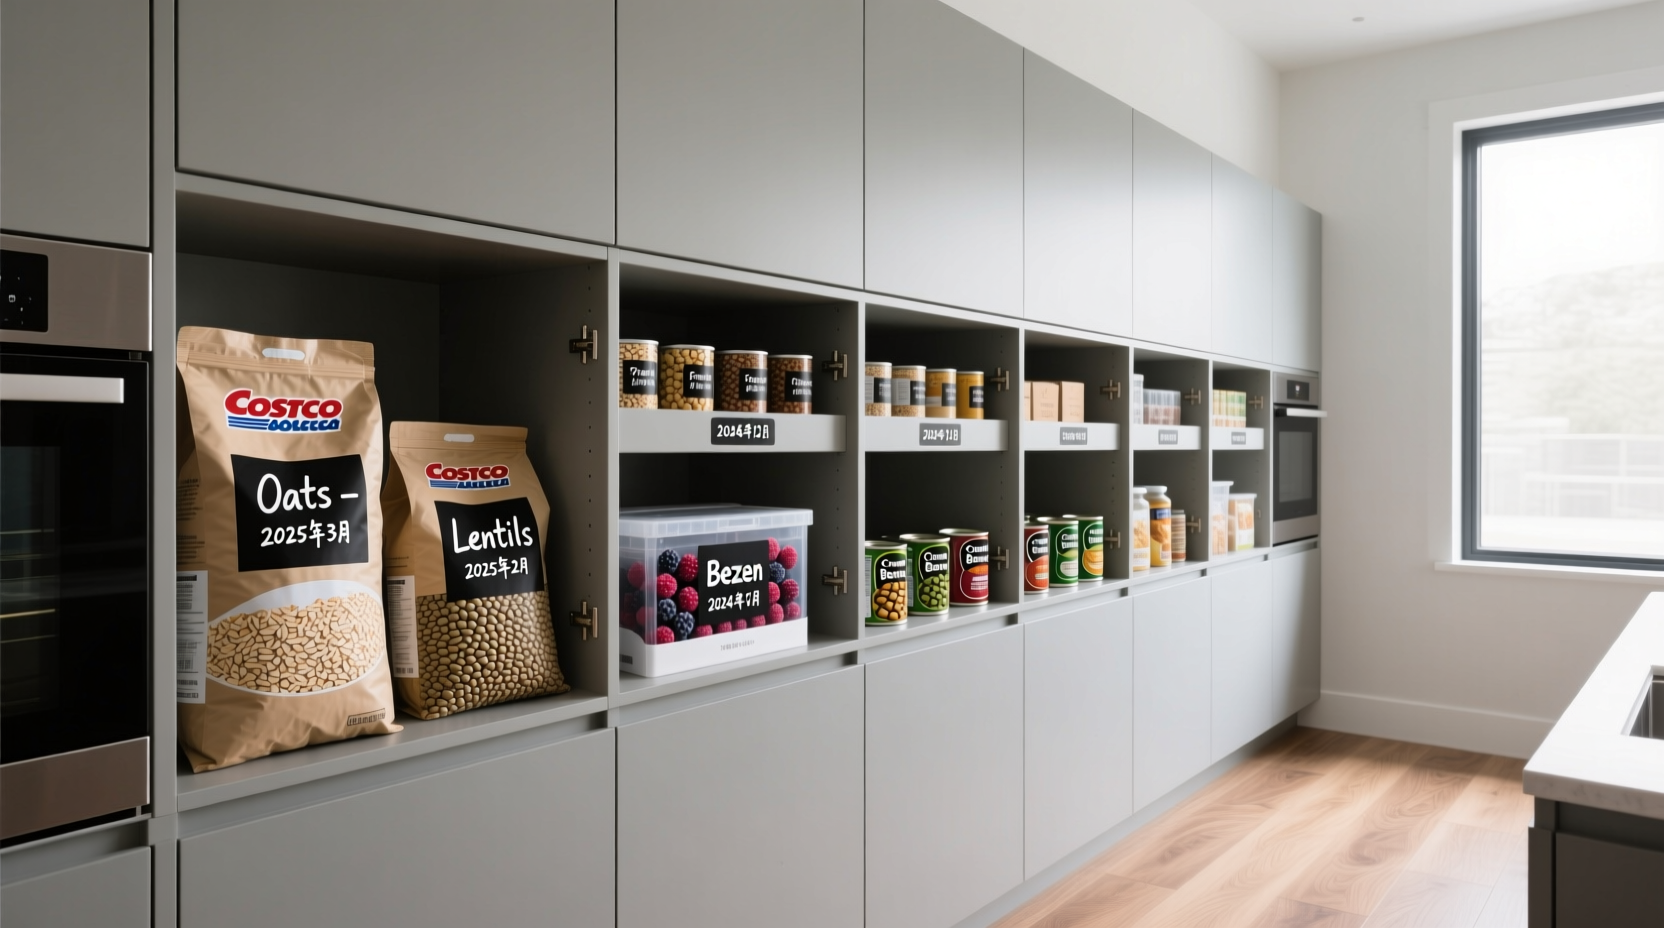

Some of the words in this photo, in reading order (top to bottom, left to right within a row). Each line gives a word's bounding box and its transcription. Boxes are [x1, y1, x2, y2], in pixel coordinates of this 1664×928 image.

[225, 390, 343, 419] COSTCO
[425, 463, 509, 480] COSTCO
[256, 473, 332, 514] Oats
[260, 519, 350, 549] 2025年3月
[451, 515, 533, 554] Lentils
[464, 556, 529, 580] 2025年2月
[707, 559, 763, 588] Bezen
